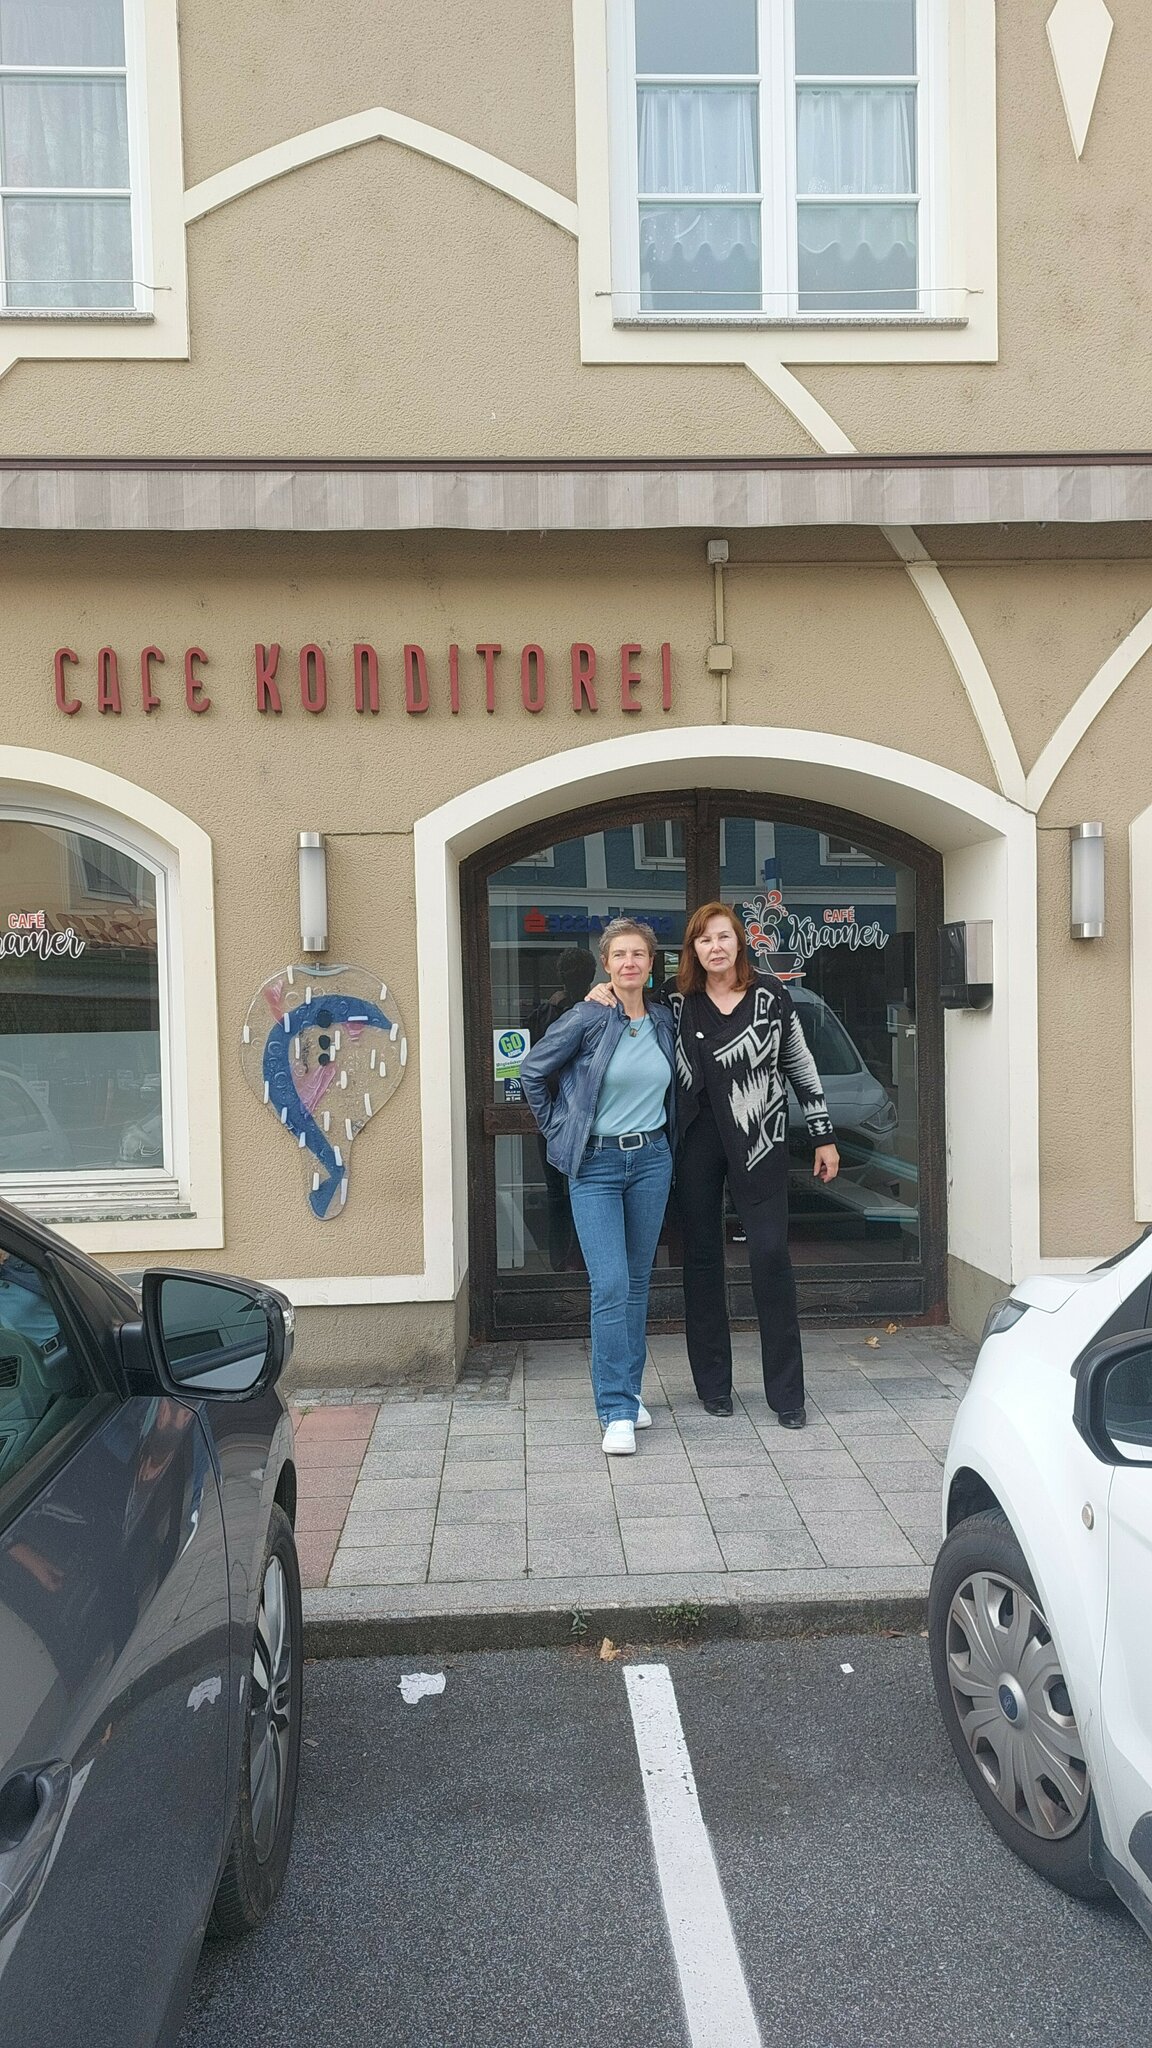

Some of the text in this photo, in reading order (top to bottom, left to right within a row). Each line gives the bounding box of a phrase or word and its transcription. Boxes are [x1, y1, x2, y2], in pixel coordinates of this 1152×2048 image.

[53, 642, 672, 715] CAFE KONDITOREI
[8, 909, 45, 929] CAFÉ
[823, 906, 856, 923] CAFÉ
[0, 927, 86, 961] amer
[787, 914, 890, 958] Kramer
[500, 1033, 523, 1053] GO
